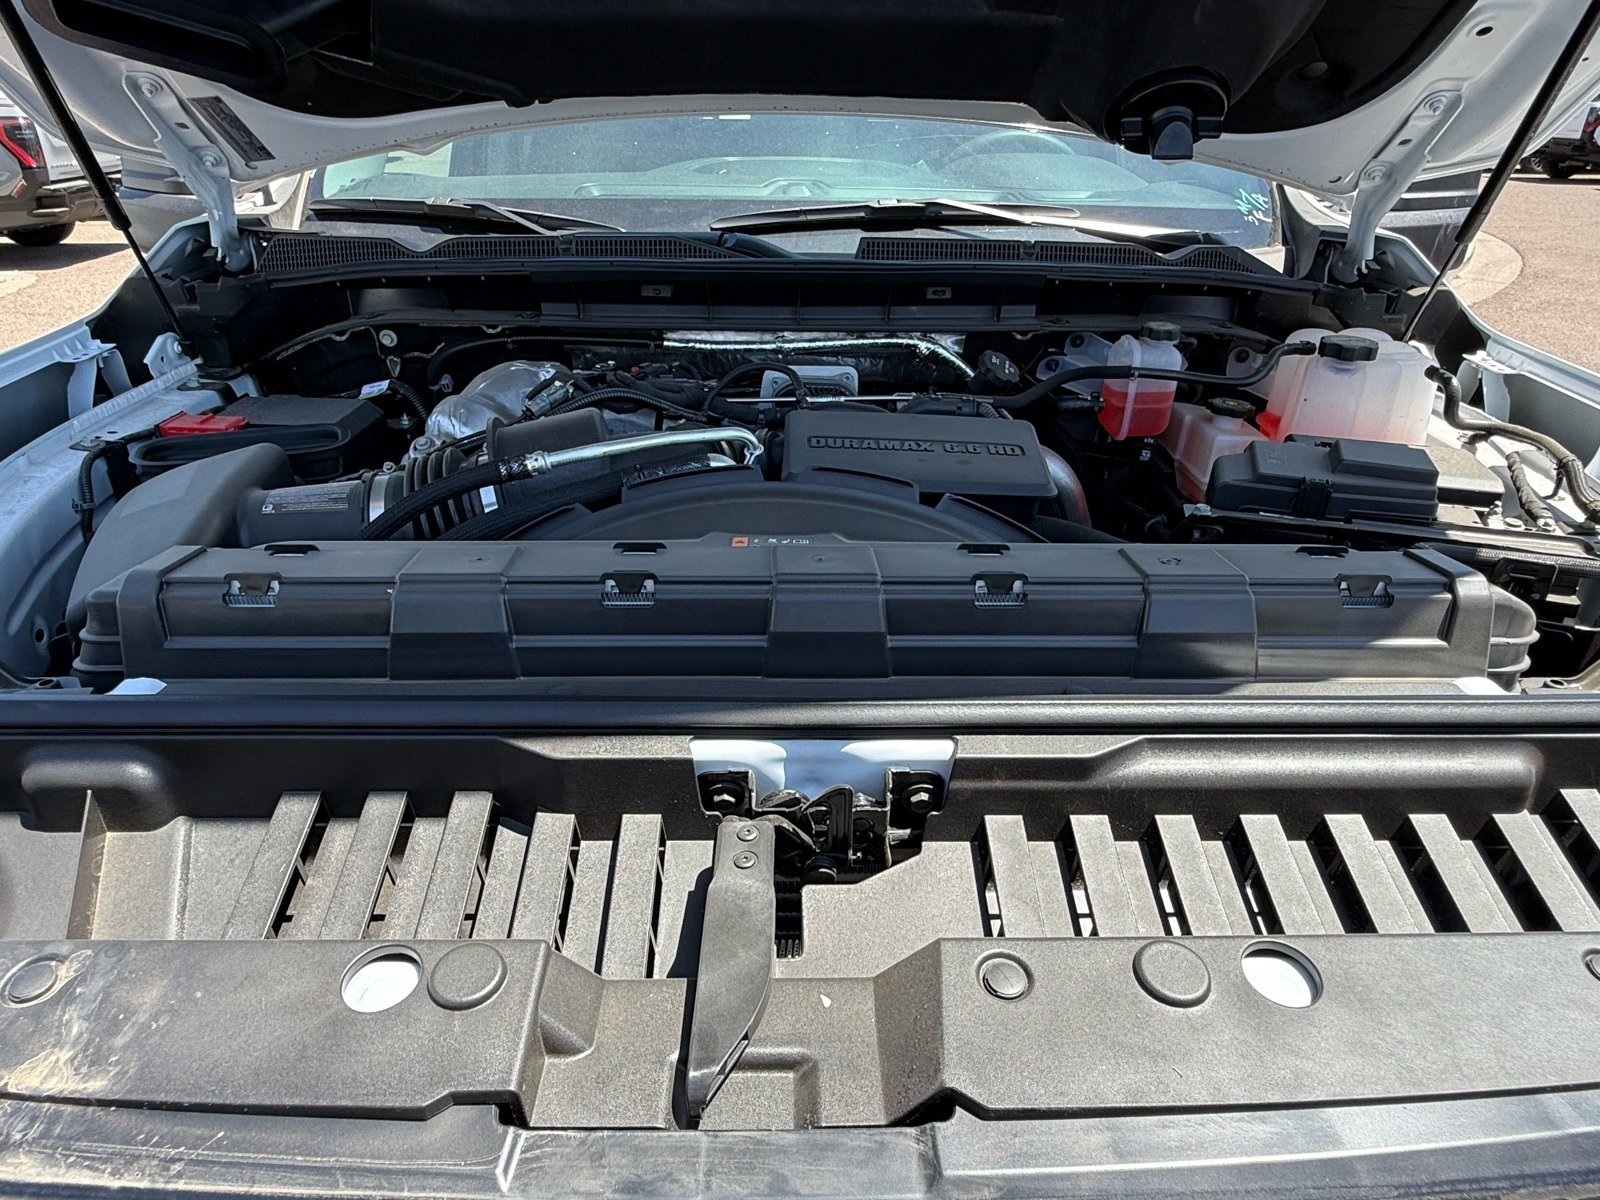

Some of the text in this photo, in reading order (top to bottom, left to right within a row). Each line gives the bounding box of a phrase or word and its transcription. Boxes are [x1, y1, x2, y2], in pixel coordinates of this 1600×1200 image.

[810, 437, 1023, 457] DURAMAX 6.6 HD
